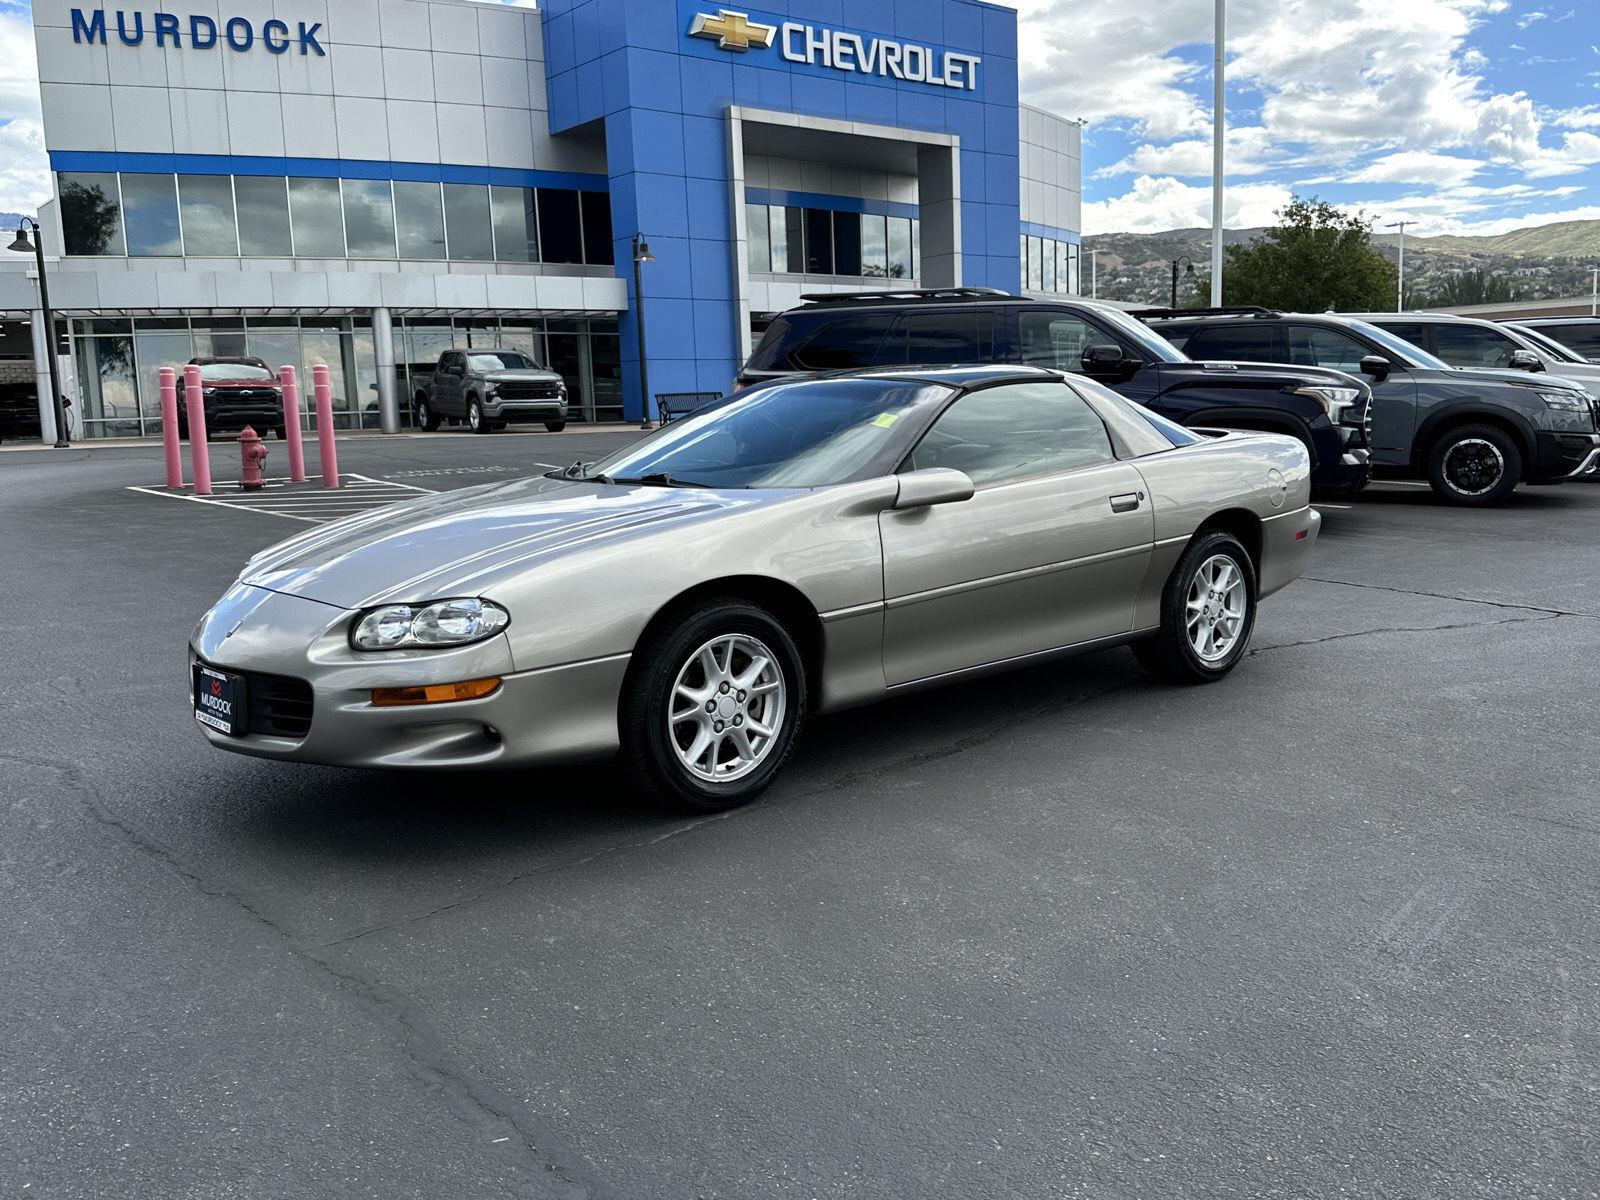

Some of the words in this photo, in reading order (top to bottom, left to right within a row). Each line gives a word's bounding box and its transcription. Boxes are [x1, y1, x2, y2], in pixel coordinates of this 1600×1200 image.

[71, 8, 326, 56] MURDOCK
[782, 21, 981, 90] CHEVROLET
[201, 692, 231, 715] MURDOCK
